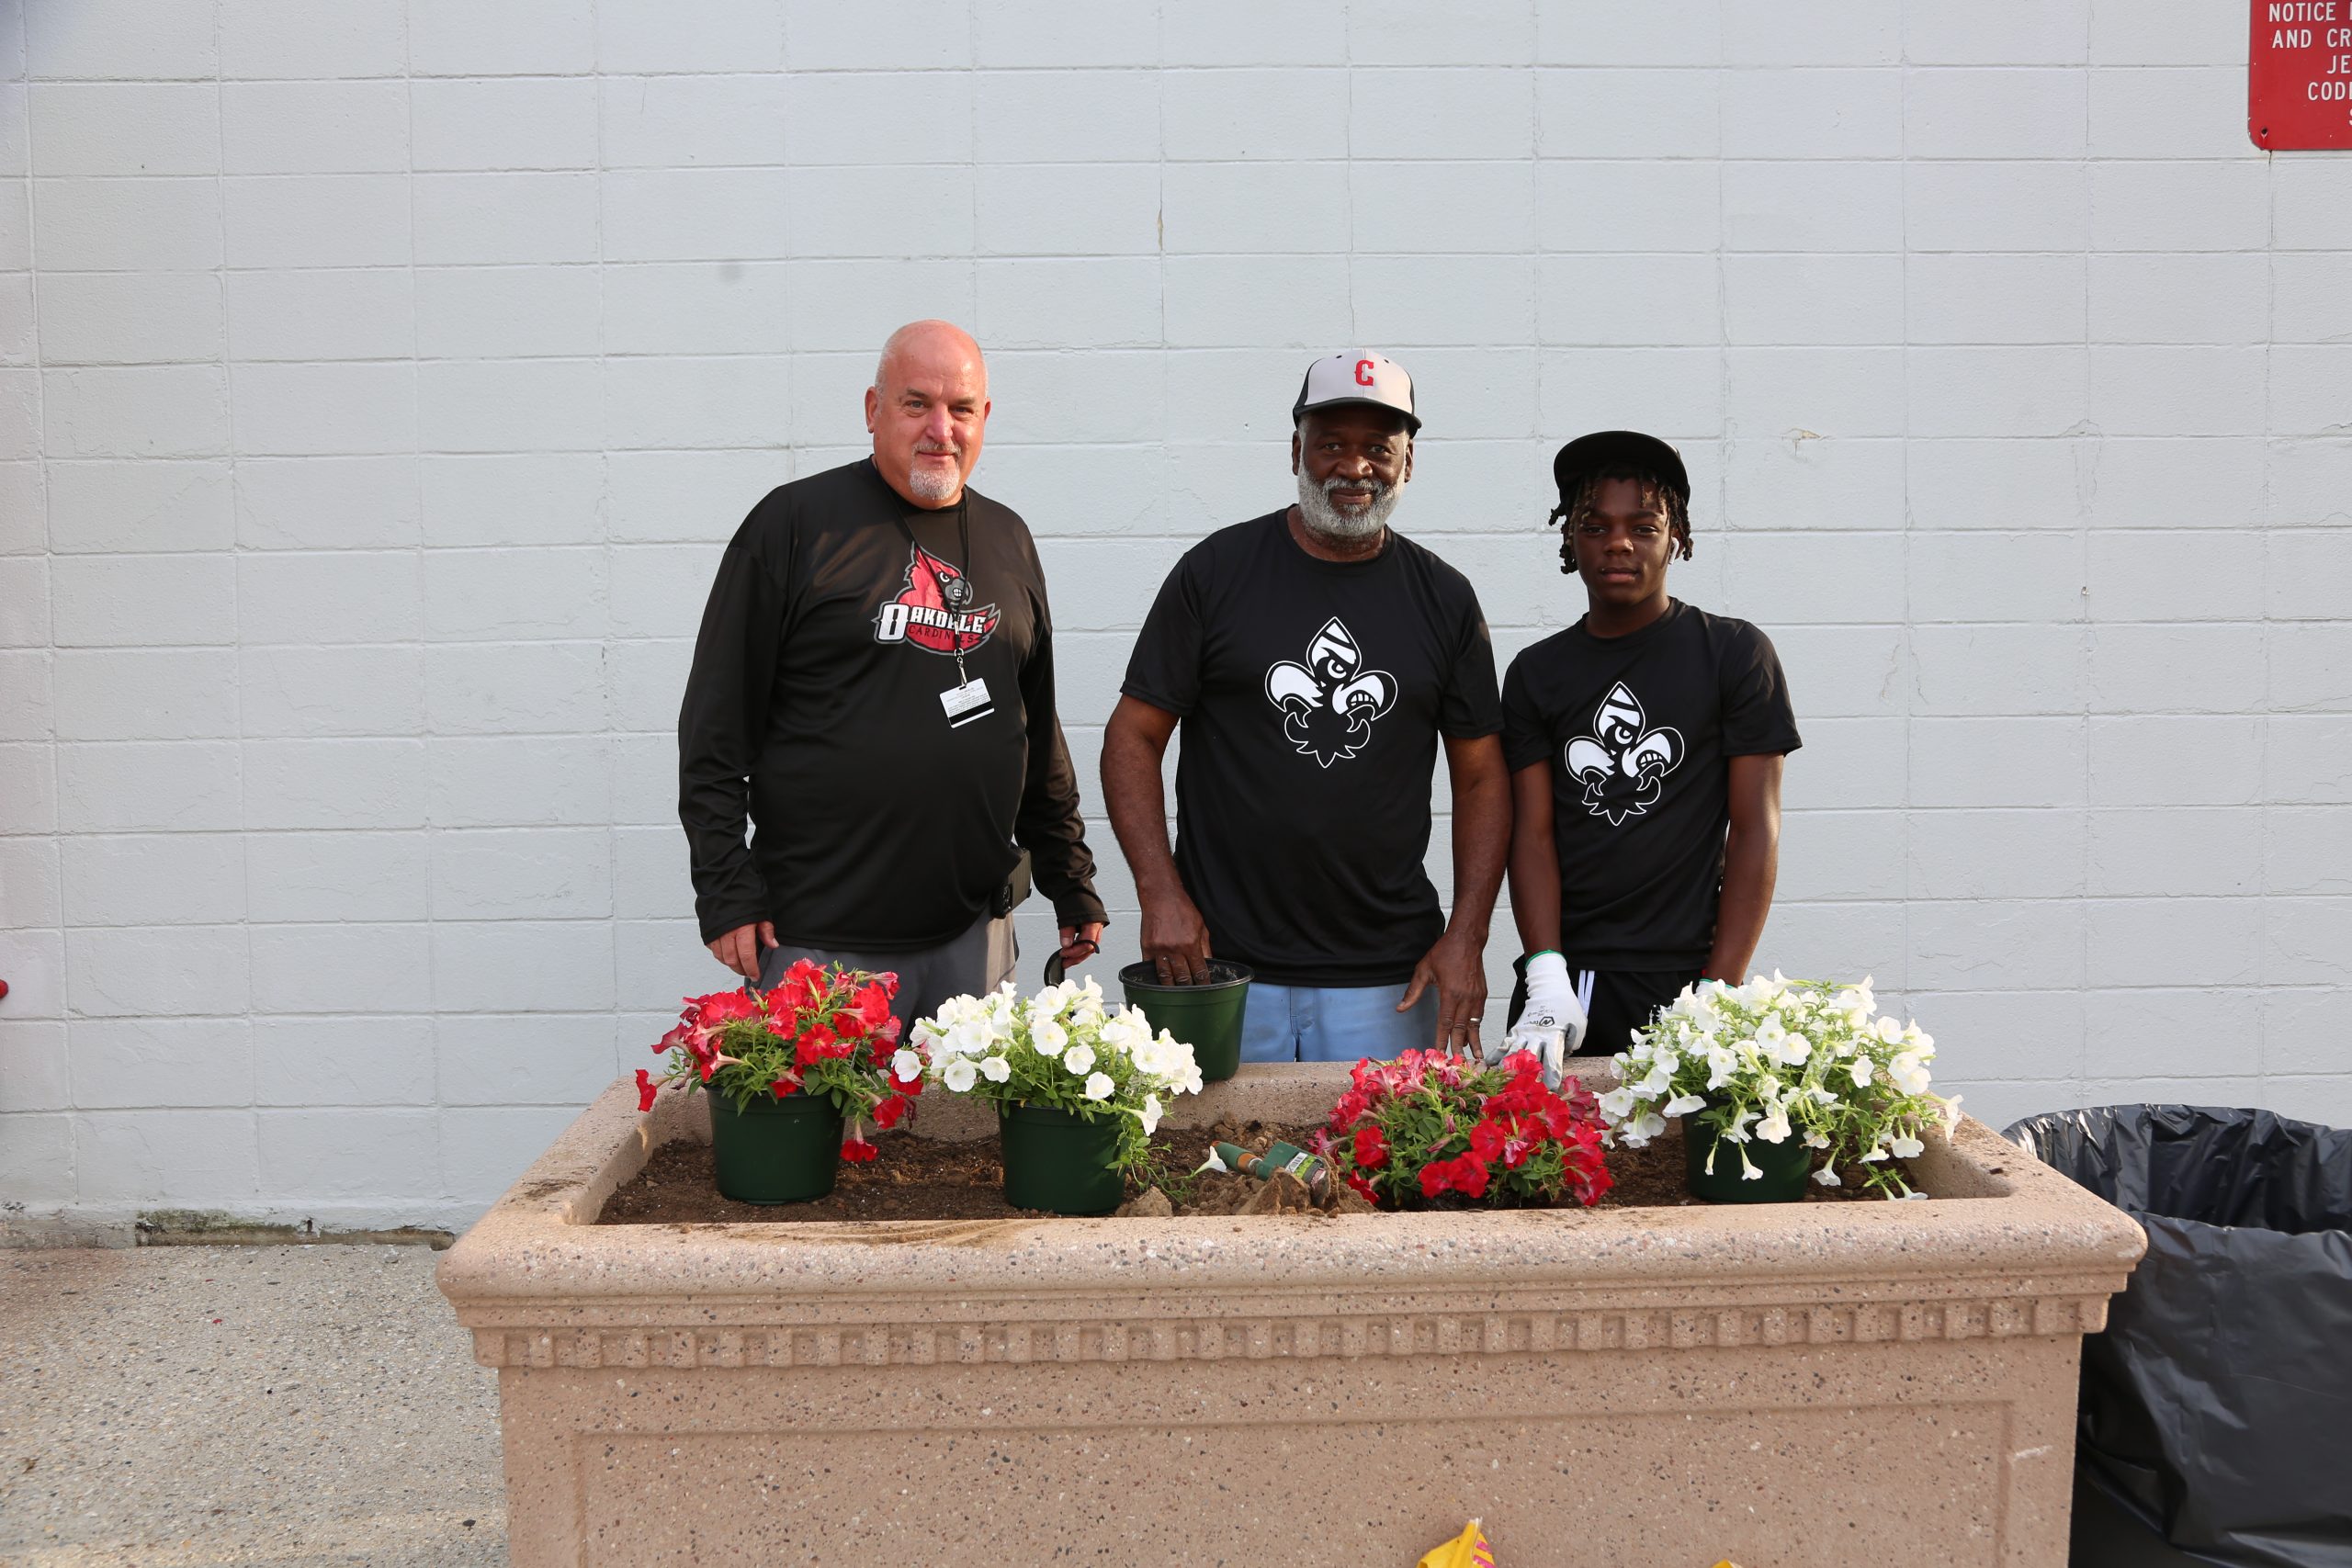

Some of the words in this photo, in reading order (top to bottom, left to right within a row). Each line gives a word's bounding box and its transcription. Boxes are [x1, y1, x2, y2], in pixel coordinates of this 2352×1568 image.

[2268, 2, 2336, 22] NOTICE
[2272, 29, 2312, 49] AND
[2326, 55, 2352, 74] JE
[1354, 359, 1374, 386] C
[908, 625, 975, 643] CARDINLS
